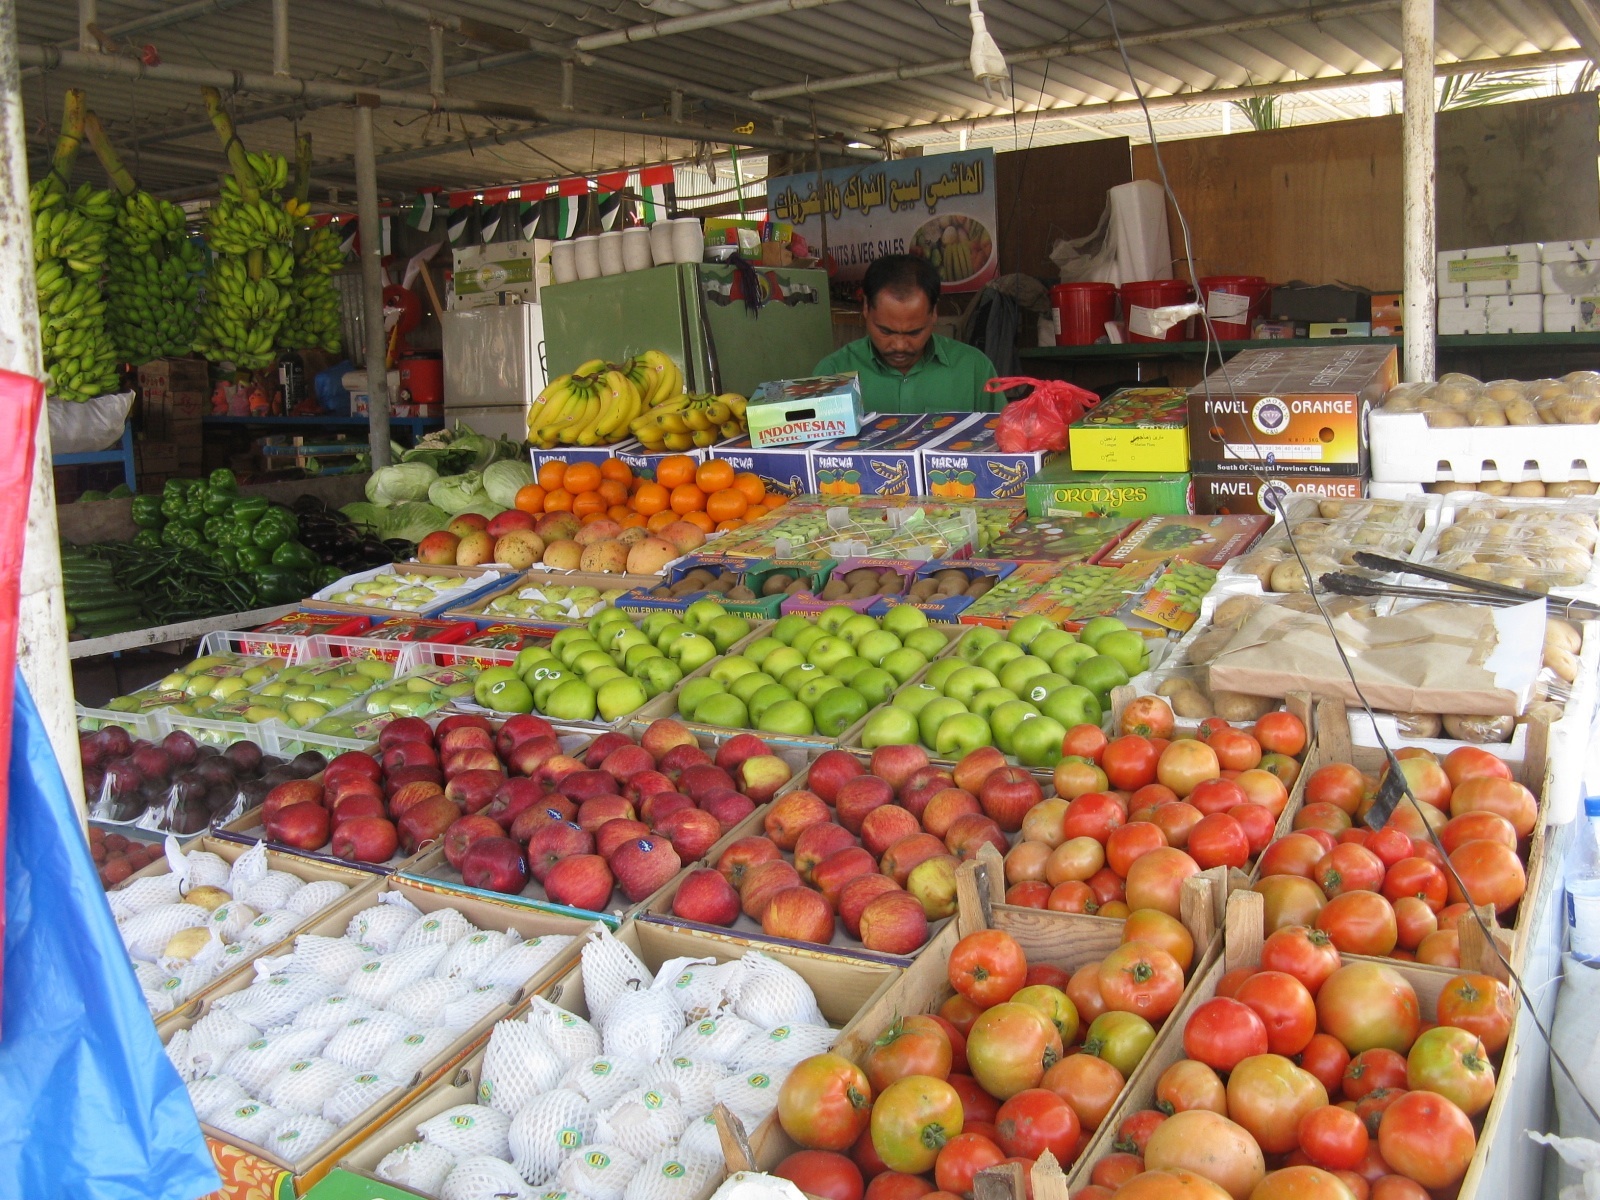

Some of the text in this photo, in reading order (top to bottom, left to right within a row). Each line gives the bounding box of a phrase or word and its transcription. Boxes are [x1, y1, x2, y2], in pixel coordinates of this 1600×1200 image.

[888, 167, 922, 212] لبيع
[925, 159, 985, 214] الهاشمي
[774, 180, 842, 225] والضروات
[826, 244, 849, 266] RUITS
[877, 238, 905, 258] SALES
[1204, 400, 1248, 414] NAVEL
[1291, 400, 1352, 414] ORANGE
[758, 420, 846, 440] INDONESIAN
[761, 430, 846, 445] EXOTIC FRUITS
[720, 456, 754, 469] ARWA
[818, 455, 853, 469] MARWA
[931, 455, 968, 469] MARWA
[1210, 482, 1253, 496] NAVEL
[1295, 483, 1356, 497] ORANGE
[1110, 515, 1165, 560] MANGOSTEEN
[743, 611, 763, 619] IRAN
